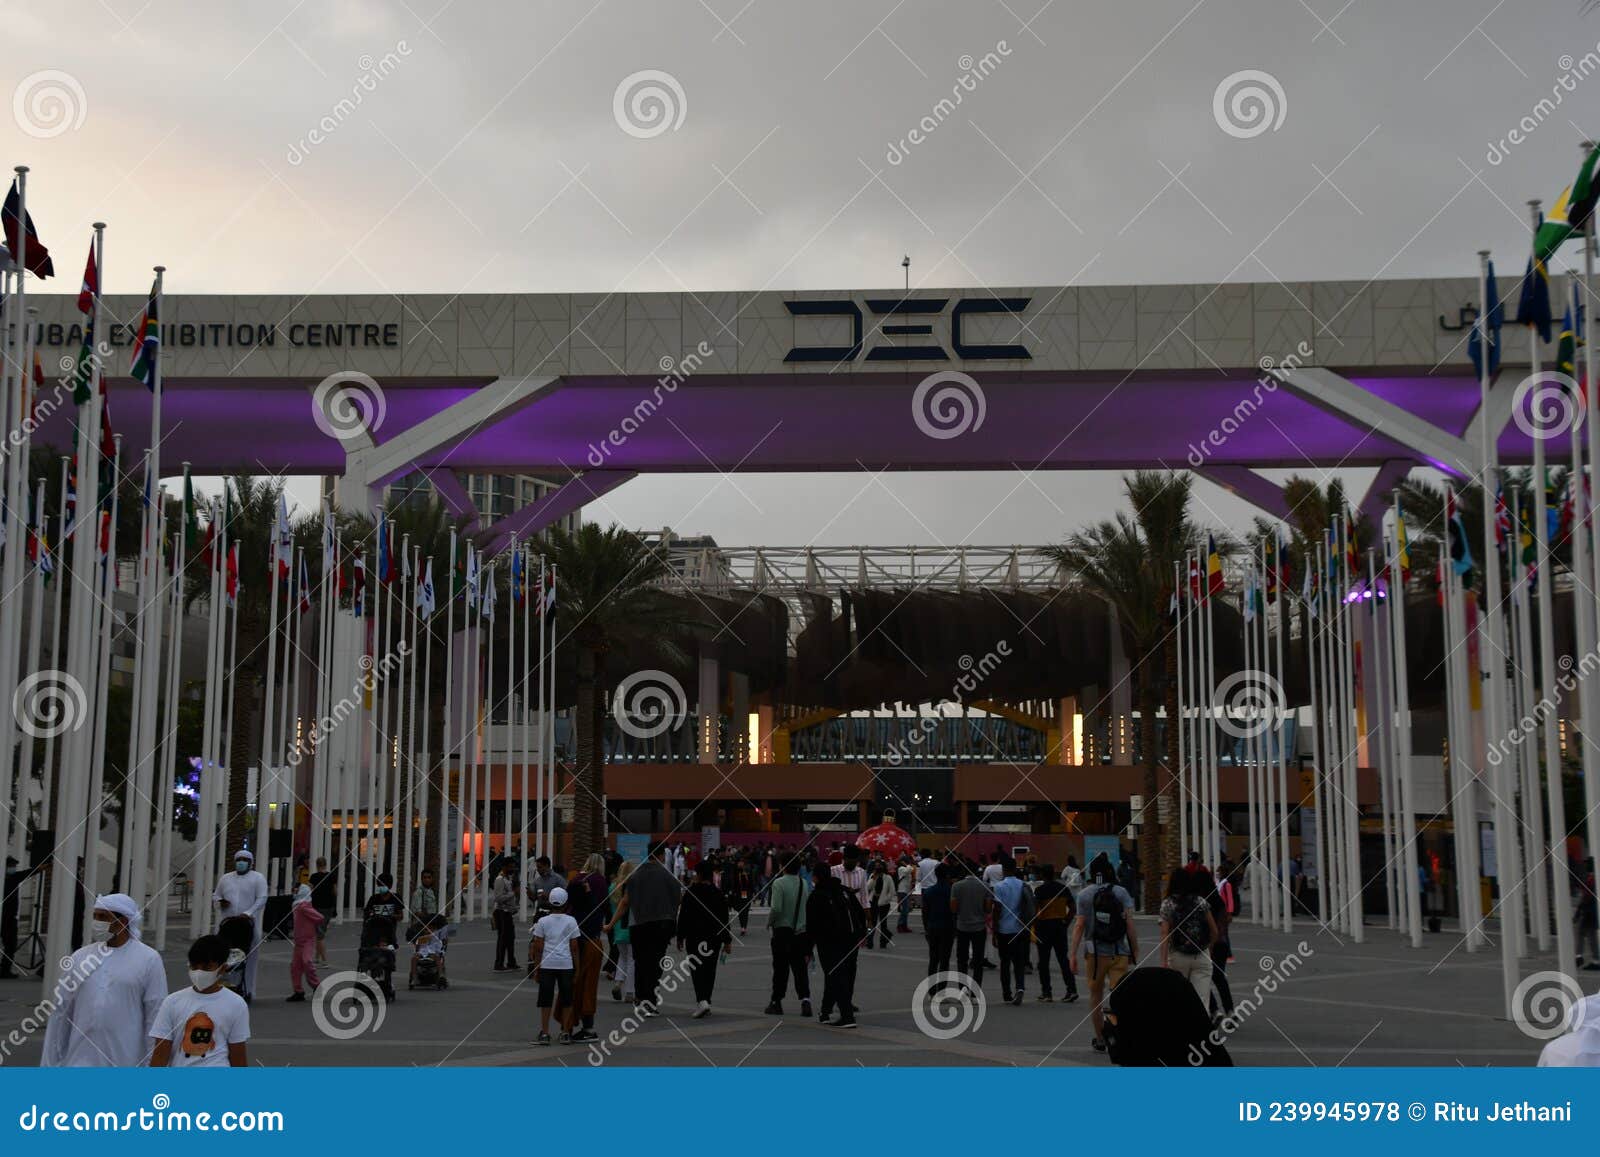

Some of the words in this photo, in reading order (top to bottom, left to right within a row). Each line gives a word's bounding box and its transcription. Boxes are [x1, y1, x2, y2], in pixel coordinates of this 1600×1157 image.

[8, 323, 91, 346] UBA
[290, 323, 399, 347] CENTRE
[783, 298, 1033, 362] DEC
